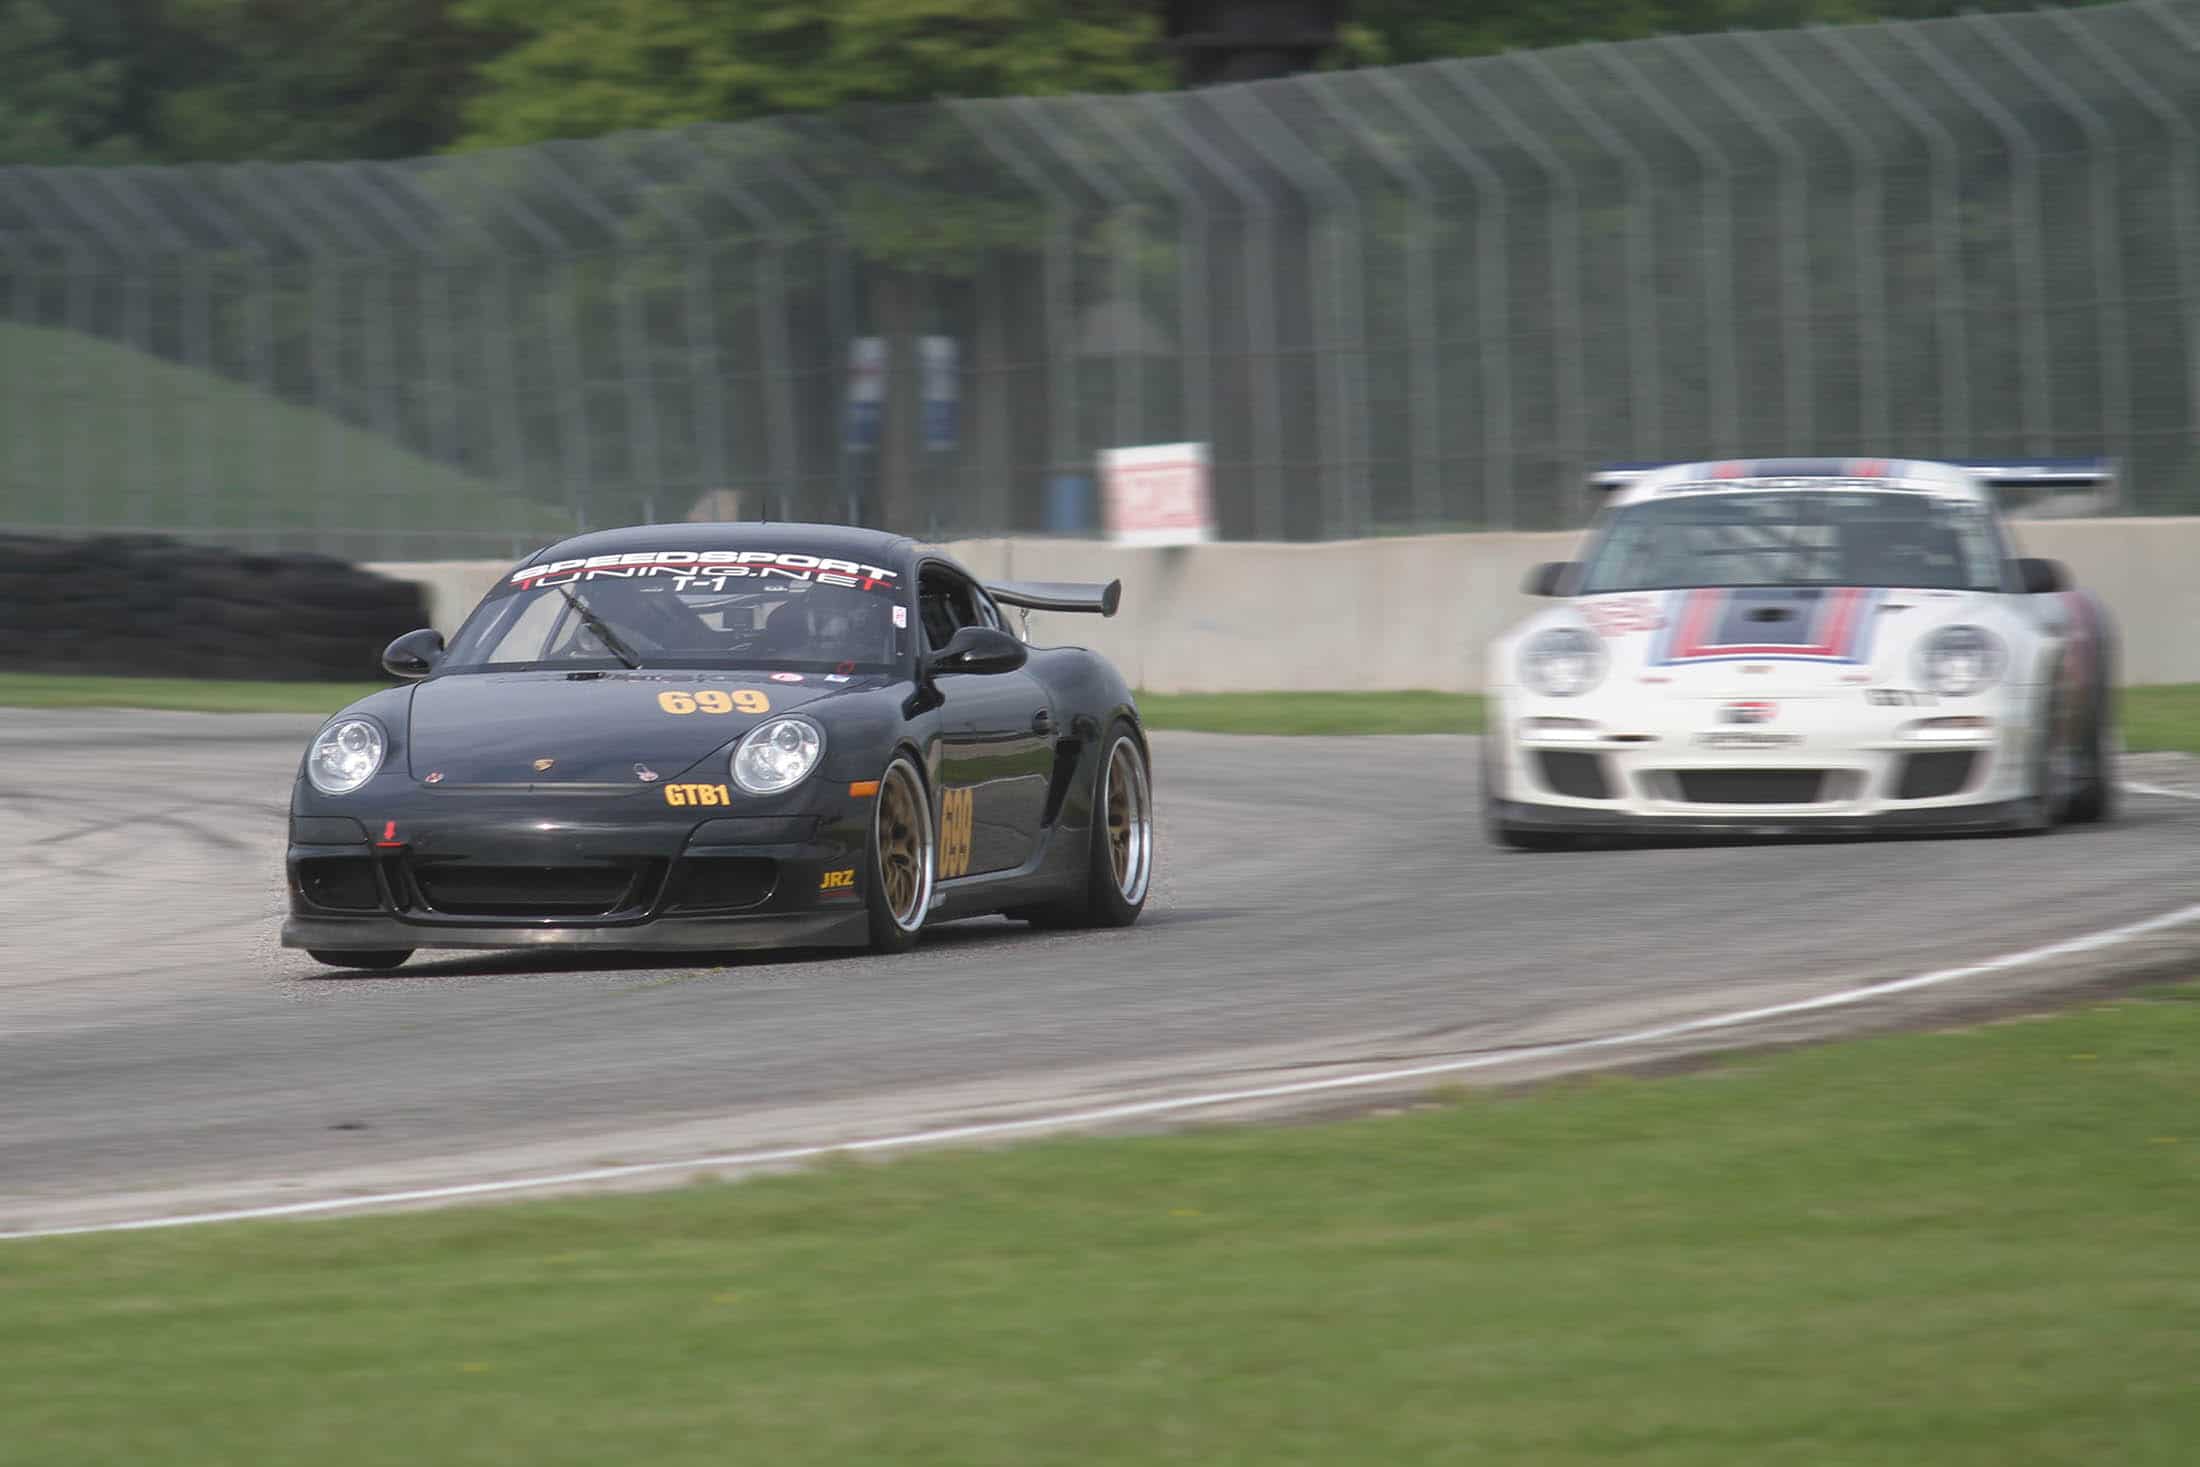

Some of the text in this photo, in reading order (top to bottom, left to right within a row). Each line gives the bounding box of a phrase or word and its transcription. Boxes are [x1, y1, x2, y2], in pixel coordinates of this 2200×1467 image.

[509, 565, 892, 591] TUNING.NET
[511, 551, 898, 582] SPEEDSPORT
[672, 575, 727, 592] T-1
[657, 689, 771, 715] 699
[664, 783, 732, 807] GTB1
[819, 869, 856, 889] JRZ
